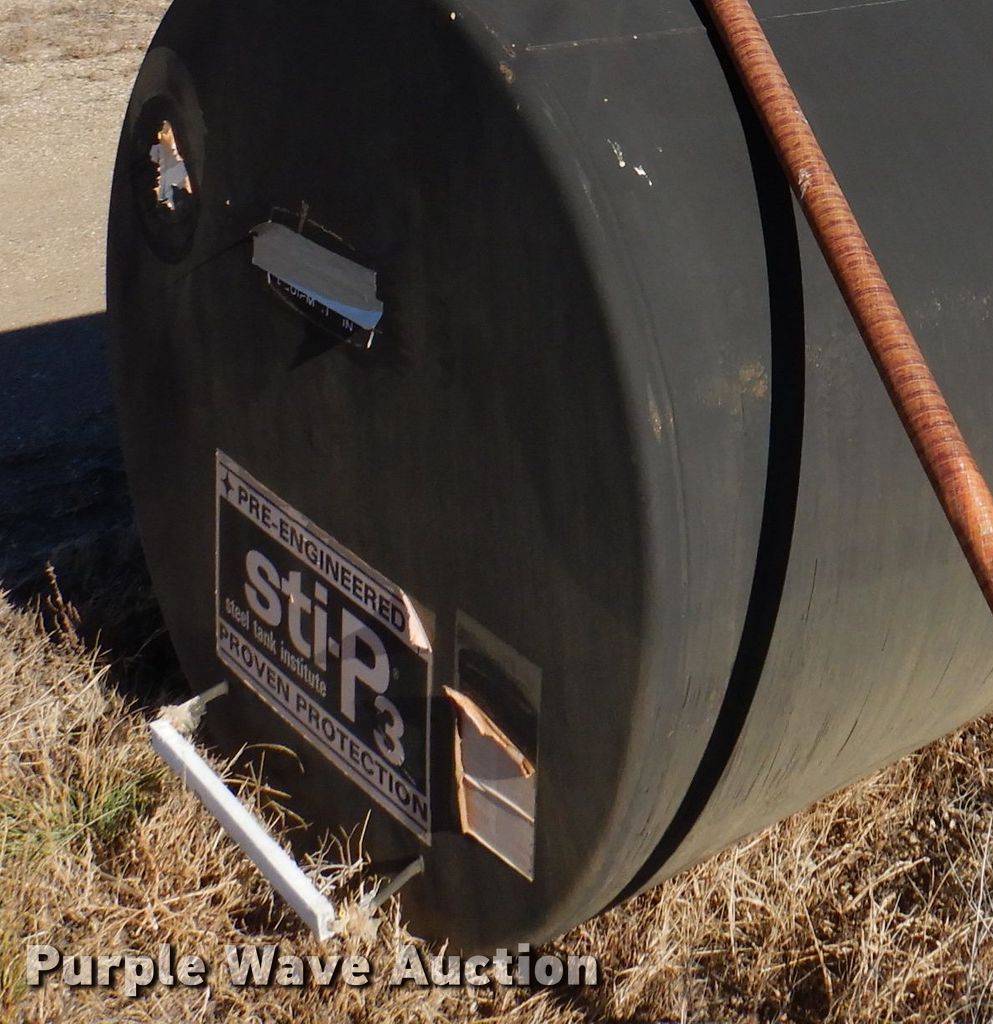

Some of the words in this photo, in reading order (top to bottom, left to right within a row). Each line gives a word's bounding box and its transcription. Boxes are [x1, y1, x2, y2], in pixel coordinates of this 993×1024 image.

[238, 485, 406, 634] PRE-ENGINEERED
[225, 598, 250, 631] steel
[253, 620, 277, 655] tank
[280, 640, 327, 698] institute
[220, 625, 290, 703] PROVEN
[296, 692, 428, 823] PROTECTION
